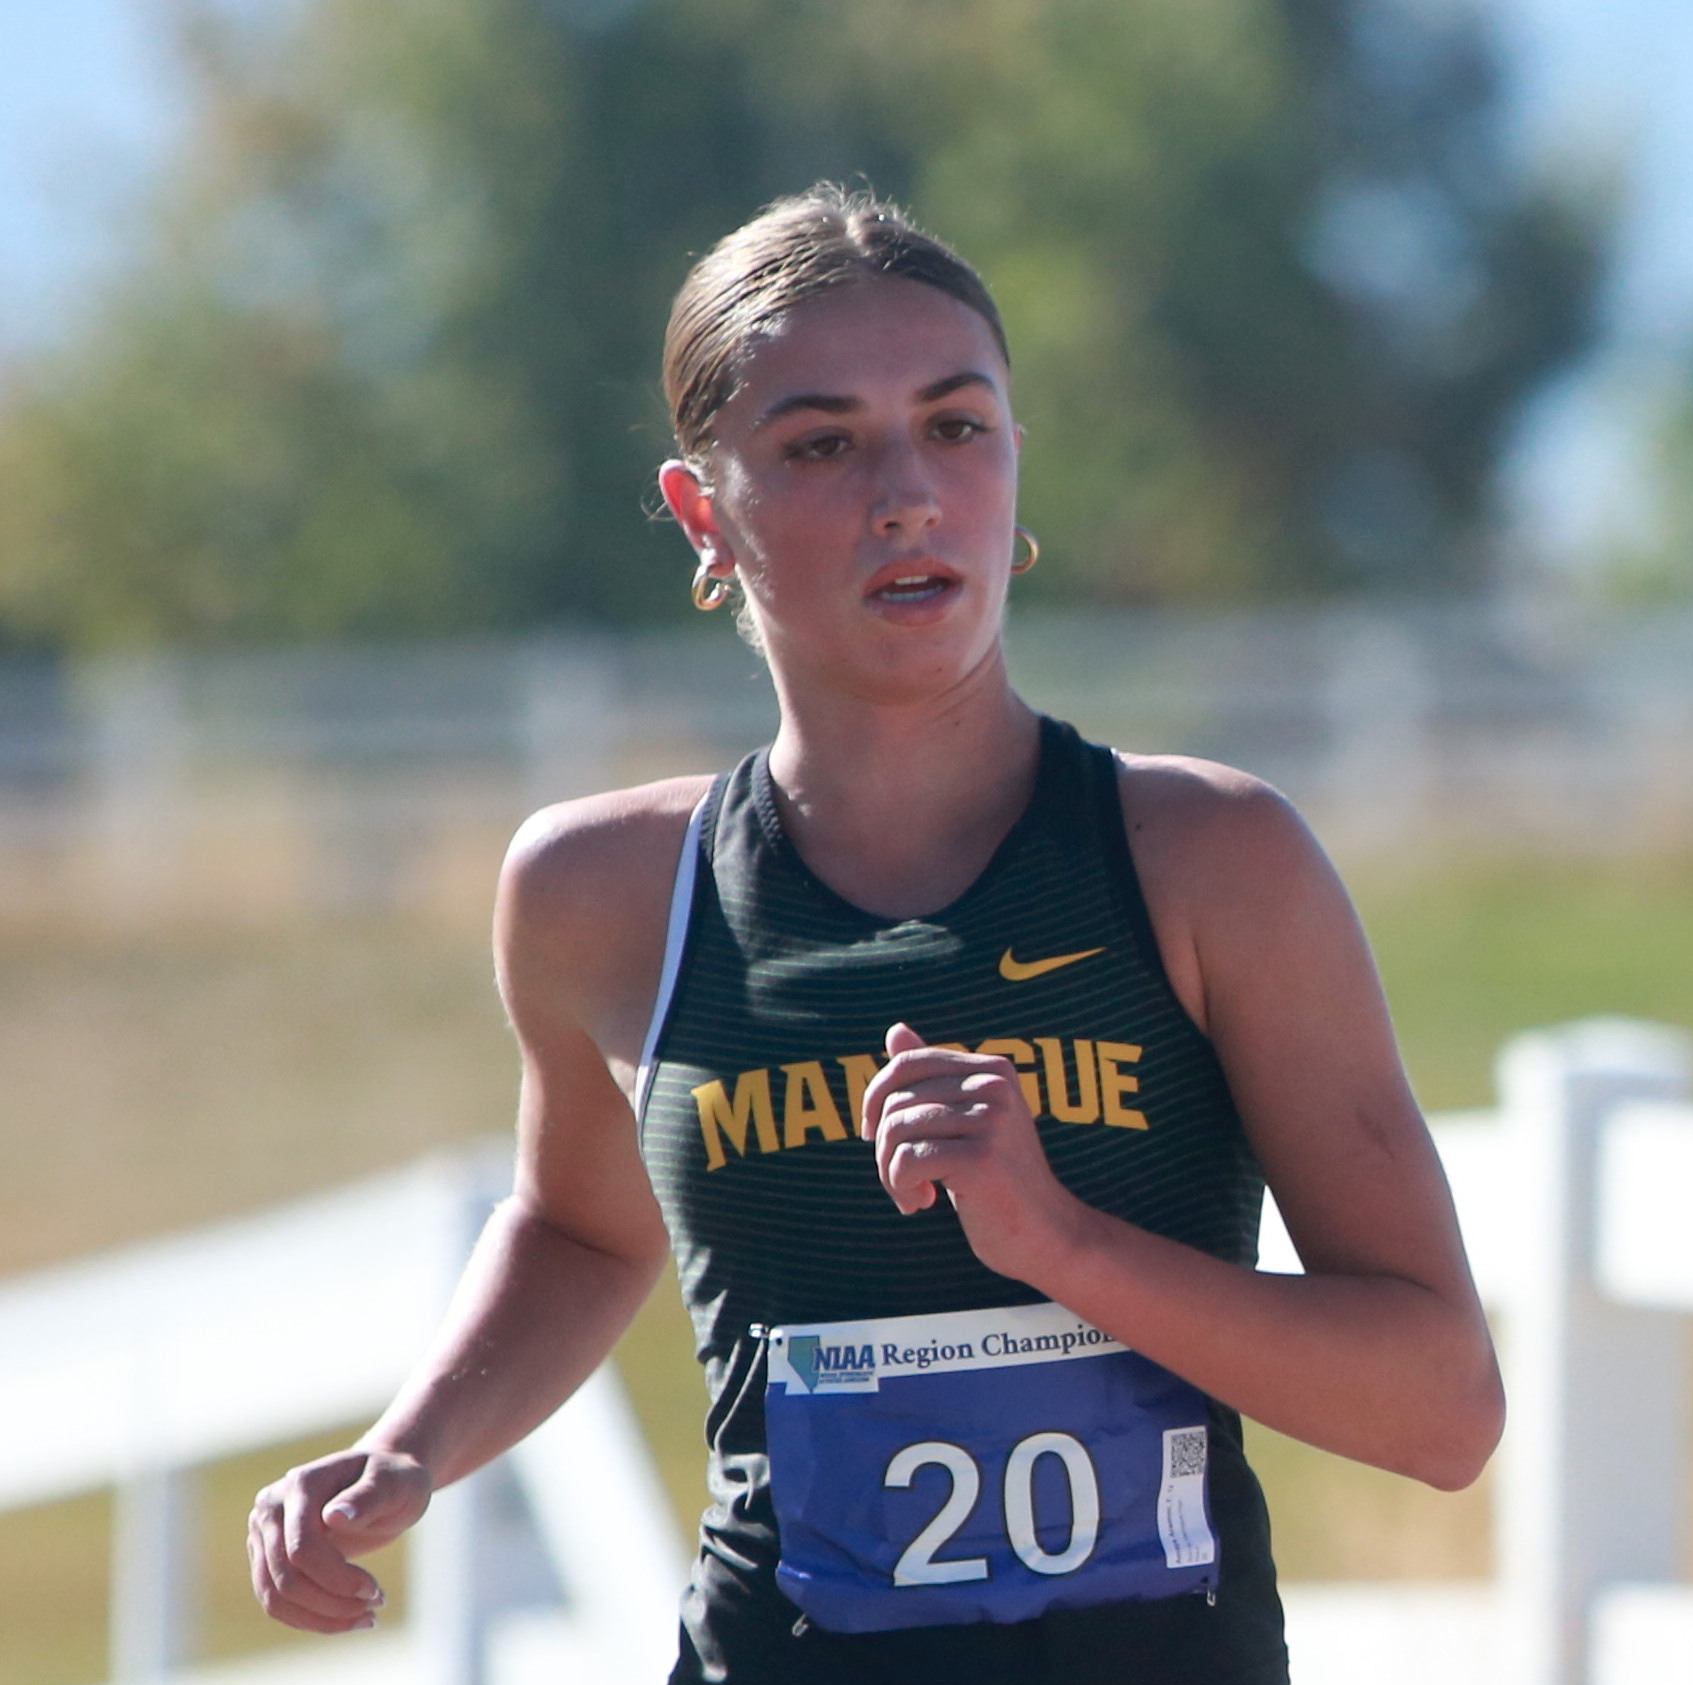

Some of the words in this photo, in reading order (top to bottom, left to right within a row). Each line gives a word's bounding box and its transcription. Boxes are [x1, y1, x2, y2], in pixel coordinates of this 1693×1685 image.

[690, 1038, 1149, 1172] MAGUE
[813, 1344, 876, 1371] NIAA
[881, 1339, 975, 1368] Region
[883, 1430, 1101, 1588] 20
